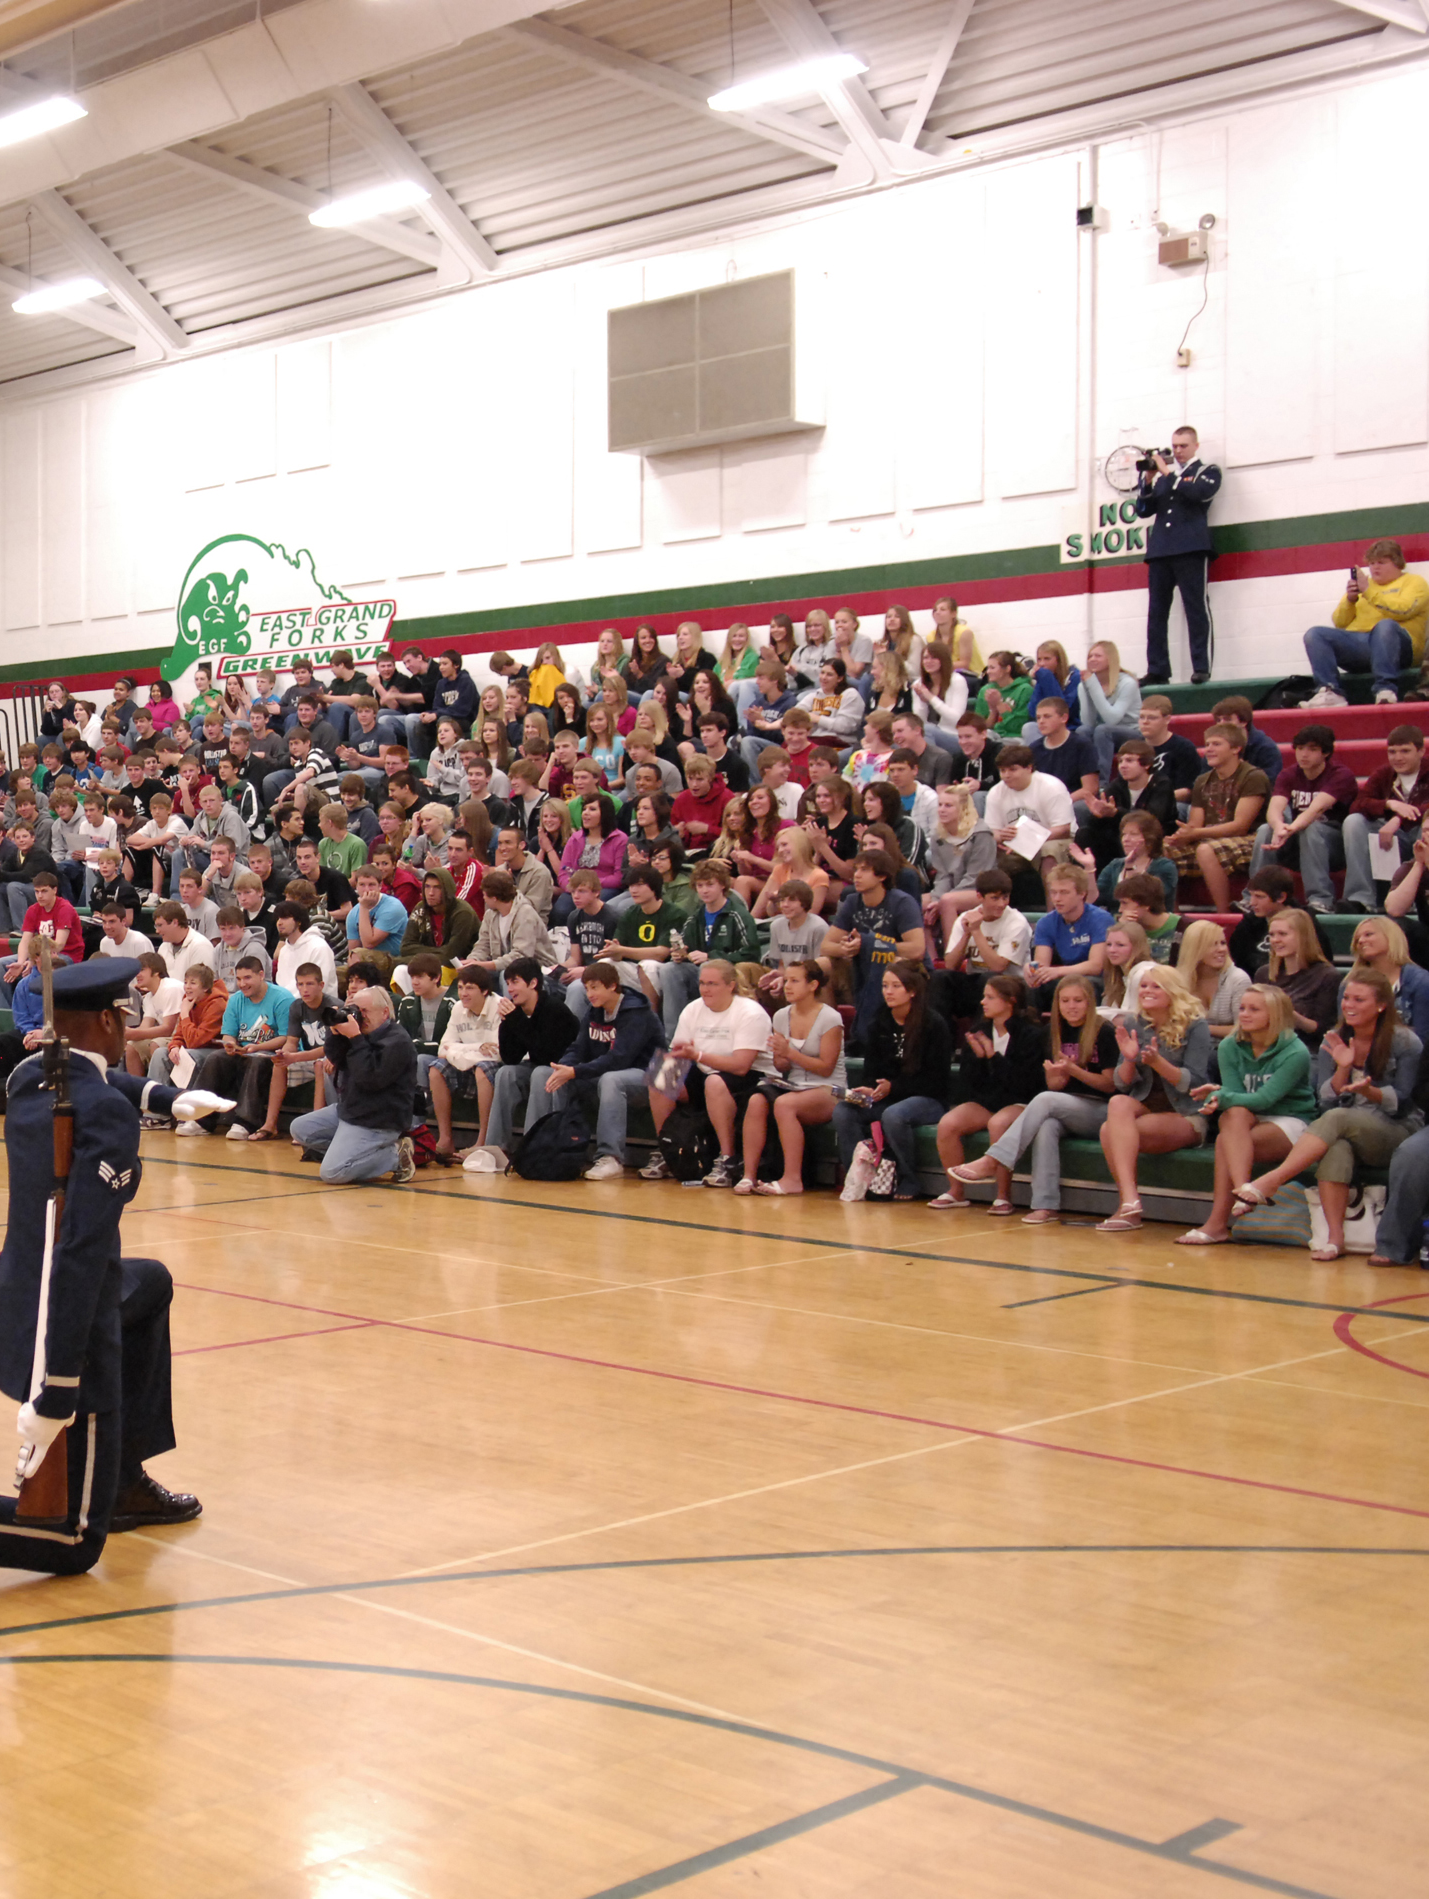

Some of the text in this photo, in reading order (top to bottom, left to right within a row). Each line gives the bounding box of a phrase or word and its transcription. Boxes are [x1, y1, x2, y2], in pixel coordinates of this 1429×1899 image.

[1099, 499, 1138, 527] NO
[259, 603, 393, 632] EAST GRAND
[199, 638, 227, 655] EGF
[269, 623, 368, 649] FORKS
